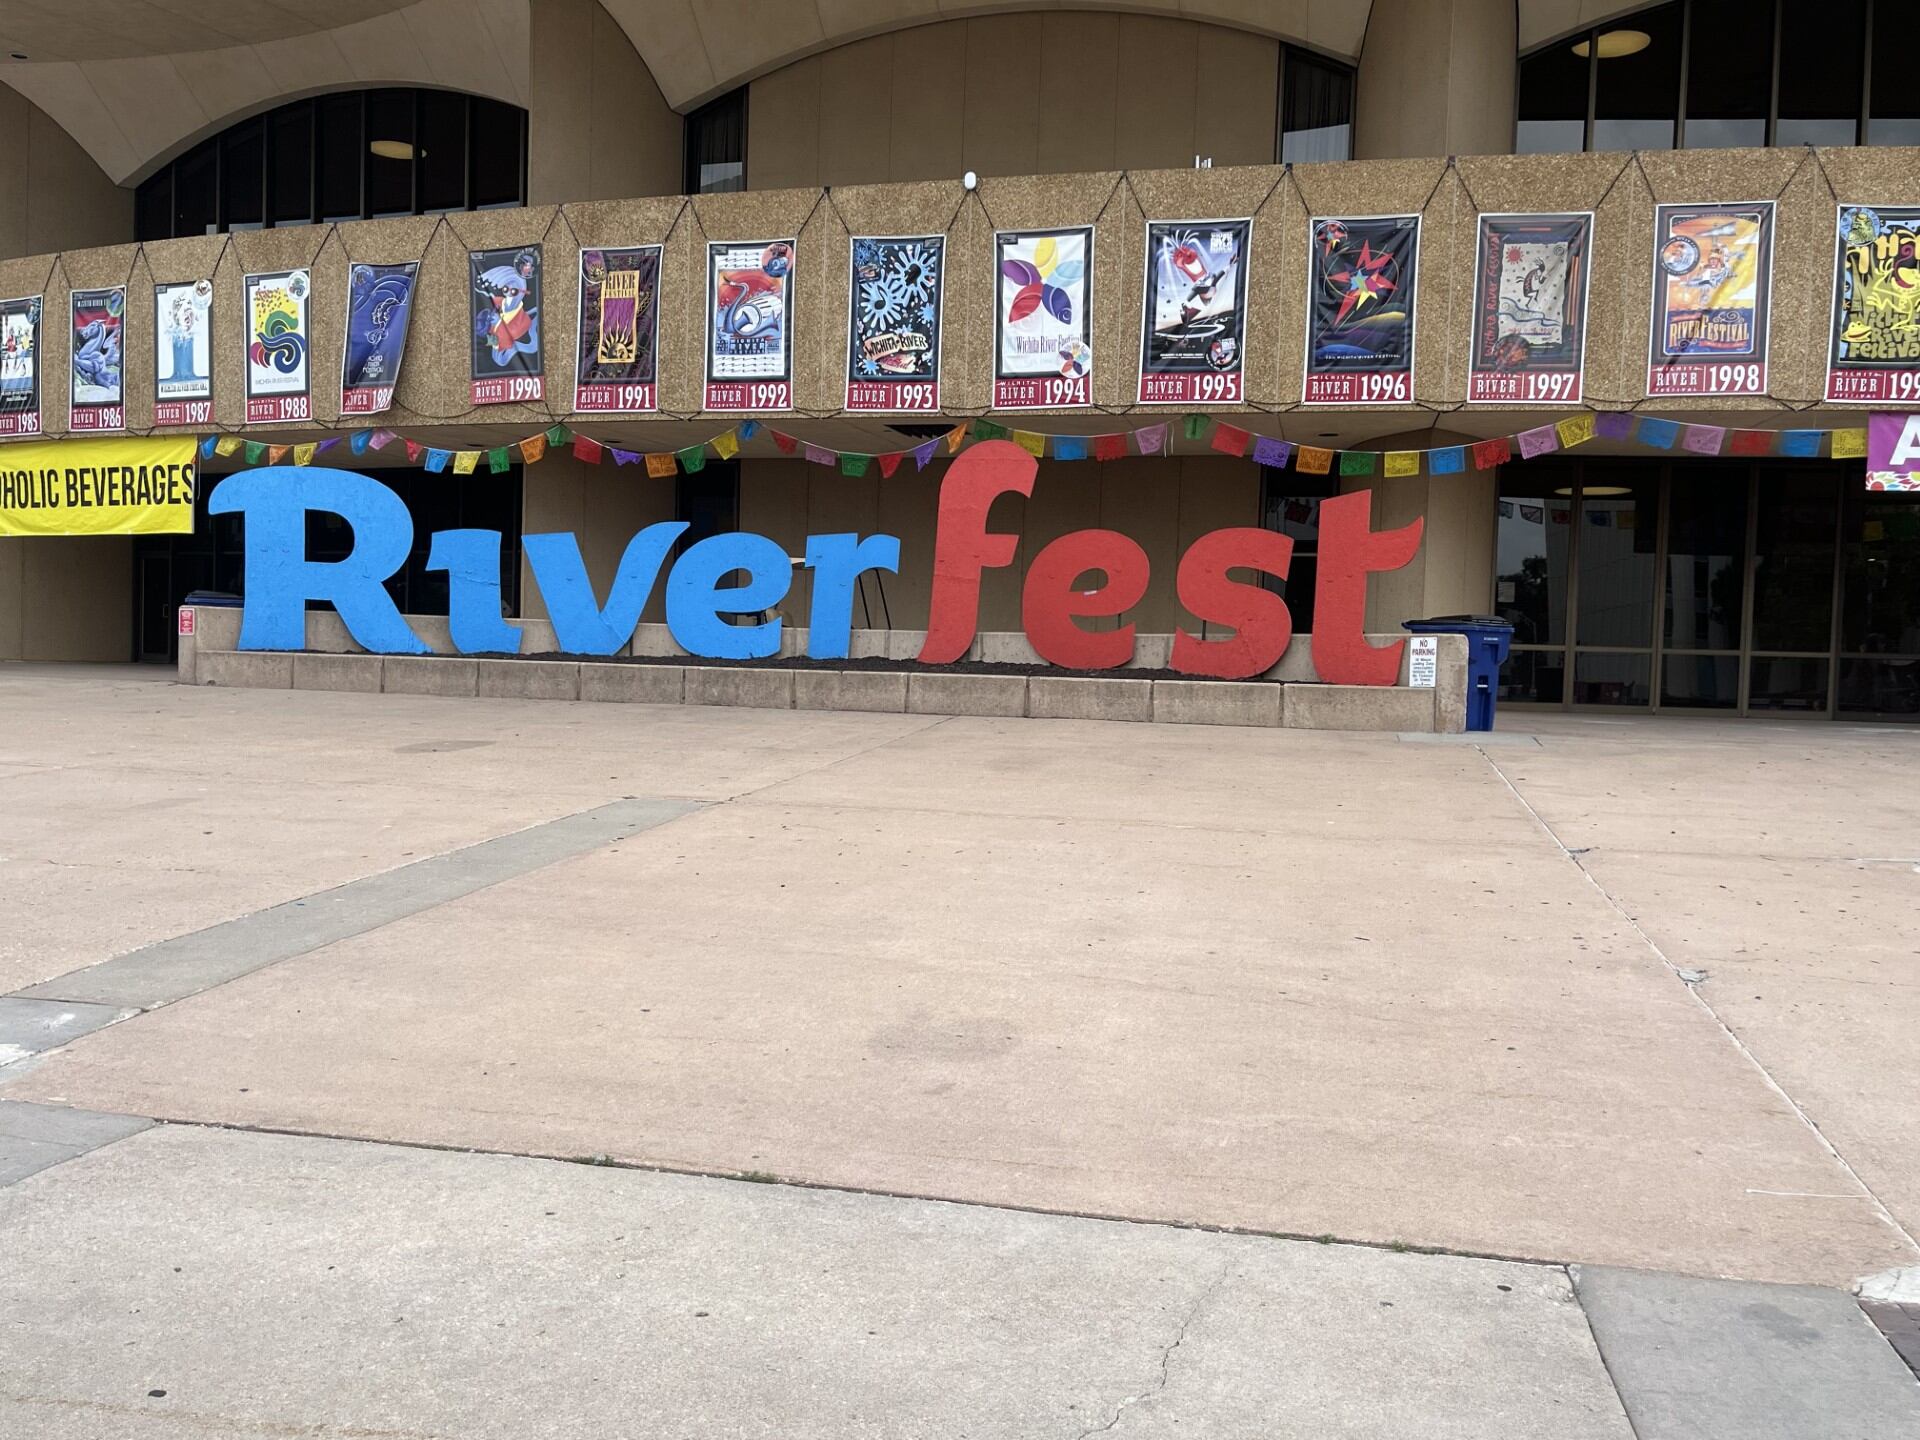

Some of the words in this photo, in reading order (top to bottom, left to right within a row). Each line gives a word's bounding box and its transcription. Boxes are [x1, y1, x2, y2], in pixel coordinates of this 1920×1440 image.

[476, 385, 502, 398] RIVER
[509, 377, 541, 400] 1990
[1146, 381, 1183, 394] RIVER
[1194, 374, 1236, 400] 1995
[1312, 381, 1350, 394] RIVER
[1361, 374, 1406, 400] 1996
[1476, 379, 1516, 393] RIVER
[1528, 373, 1575, 399] 1997
[1656, 372, 1697, 386] RIVER
[1709, 364, 1759, 392] 1998
[1835, 377, 1877, 392] RIVER
[581, 391, 610, 403] RIVER
[618, 385, 651, 409] 1991
[711, 390, 742, 402] RIVER
[750, 384, 788, 408] 1992
[852, 389, 886, 402] RIVER
[895, 384, 933, 409] 1993
[1000, 387, 1035, 400] RIVER
[1044, 378, 1086, 404] 1994
[98, 407, 122, 428] 1986
[185, 402, 211, 423] 1987
[280, 396, 308, 419] 1988
[17, 412, 38, 432] 1985
[0, 469, 60, 509] HOLIC
[65, 463, 193, 508] BEVERAGES
[208, 440, 1424, 687] Riverfest
[1420, 640, 1428, 648] NO
